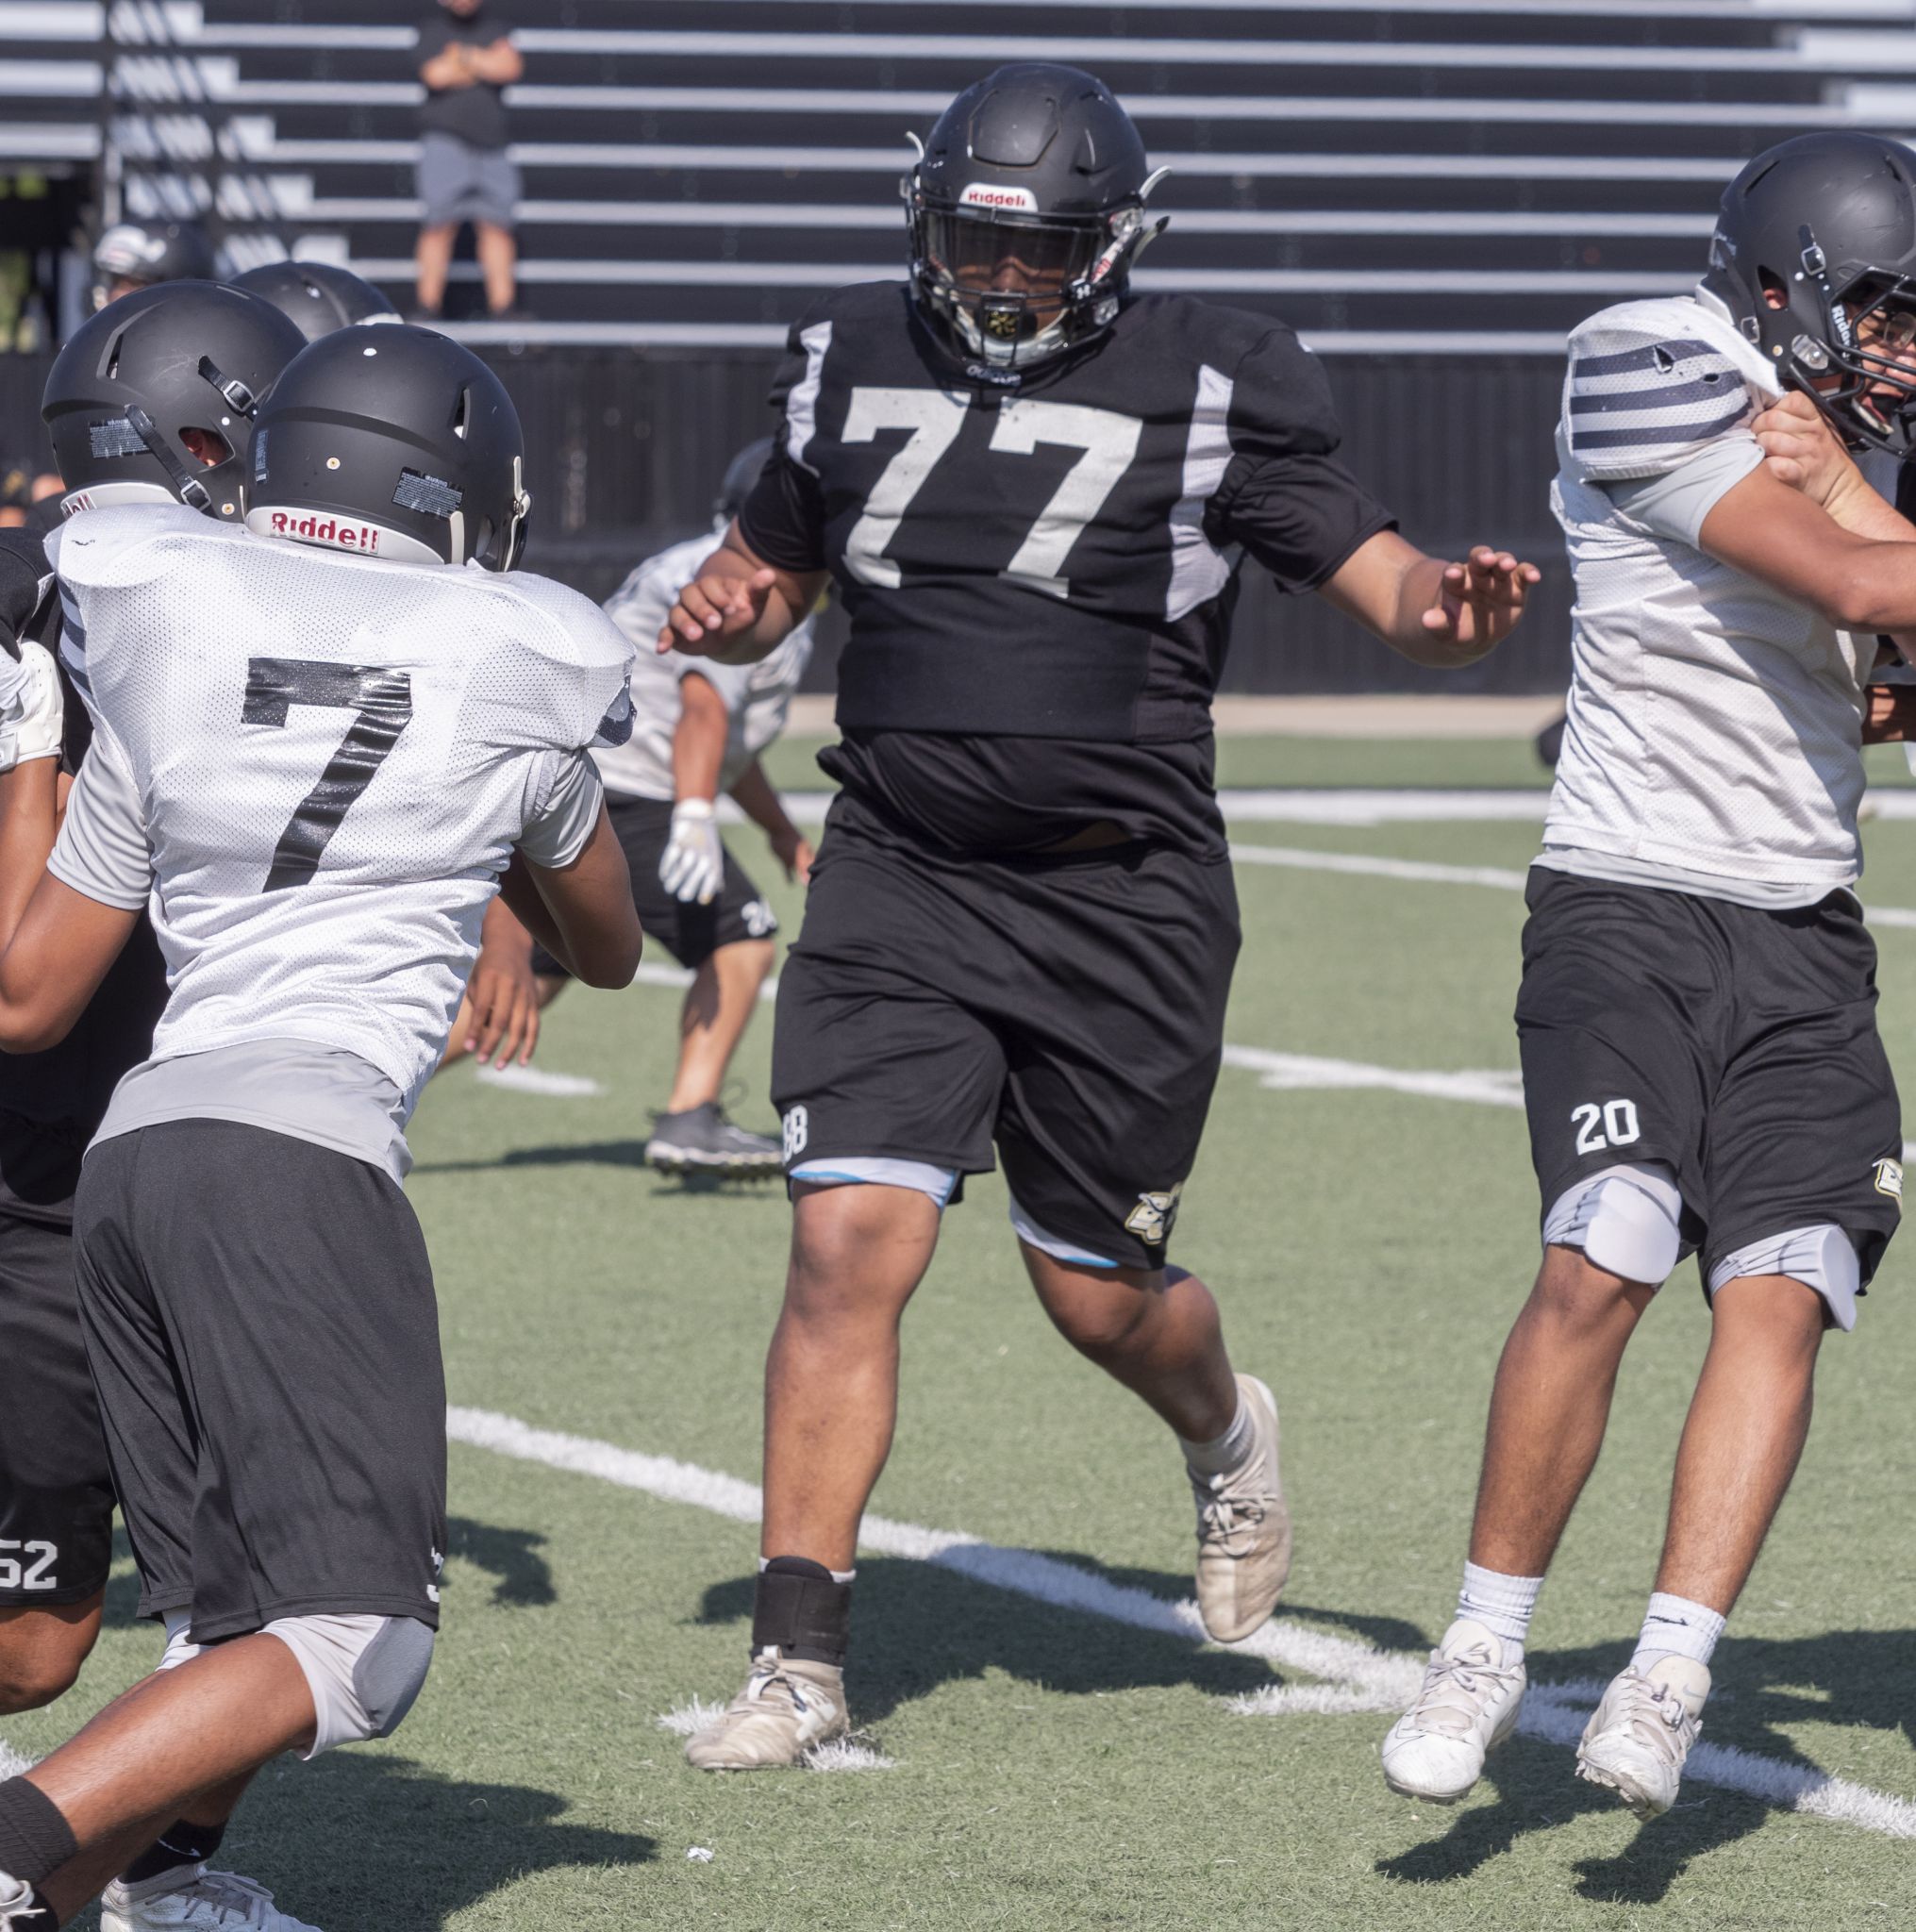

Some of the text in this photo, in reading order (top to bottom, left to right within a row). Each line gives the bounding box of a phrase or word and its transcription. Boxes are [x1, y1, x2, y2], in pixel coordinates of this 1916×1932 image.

[968, 192, 1025, 207] Riddell
[1831, 304, 1851, 348] Ridd
[841, 386, 1142, 599] 77
[271, 512, 378, 550] Riddell
[241, 657, 413, 893] 7
[1571, 1099, 1641, 1156] 20
[0, 1539, 58, 1591] 52
